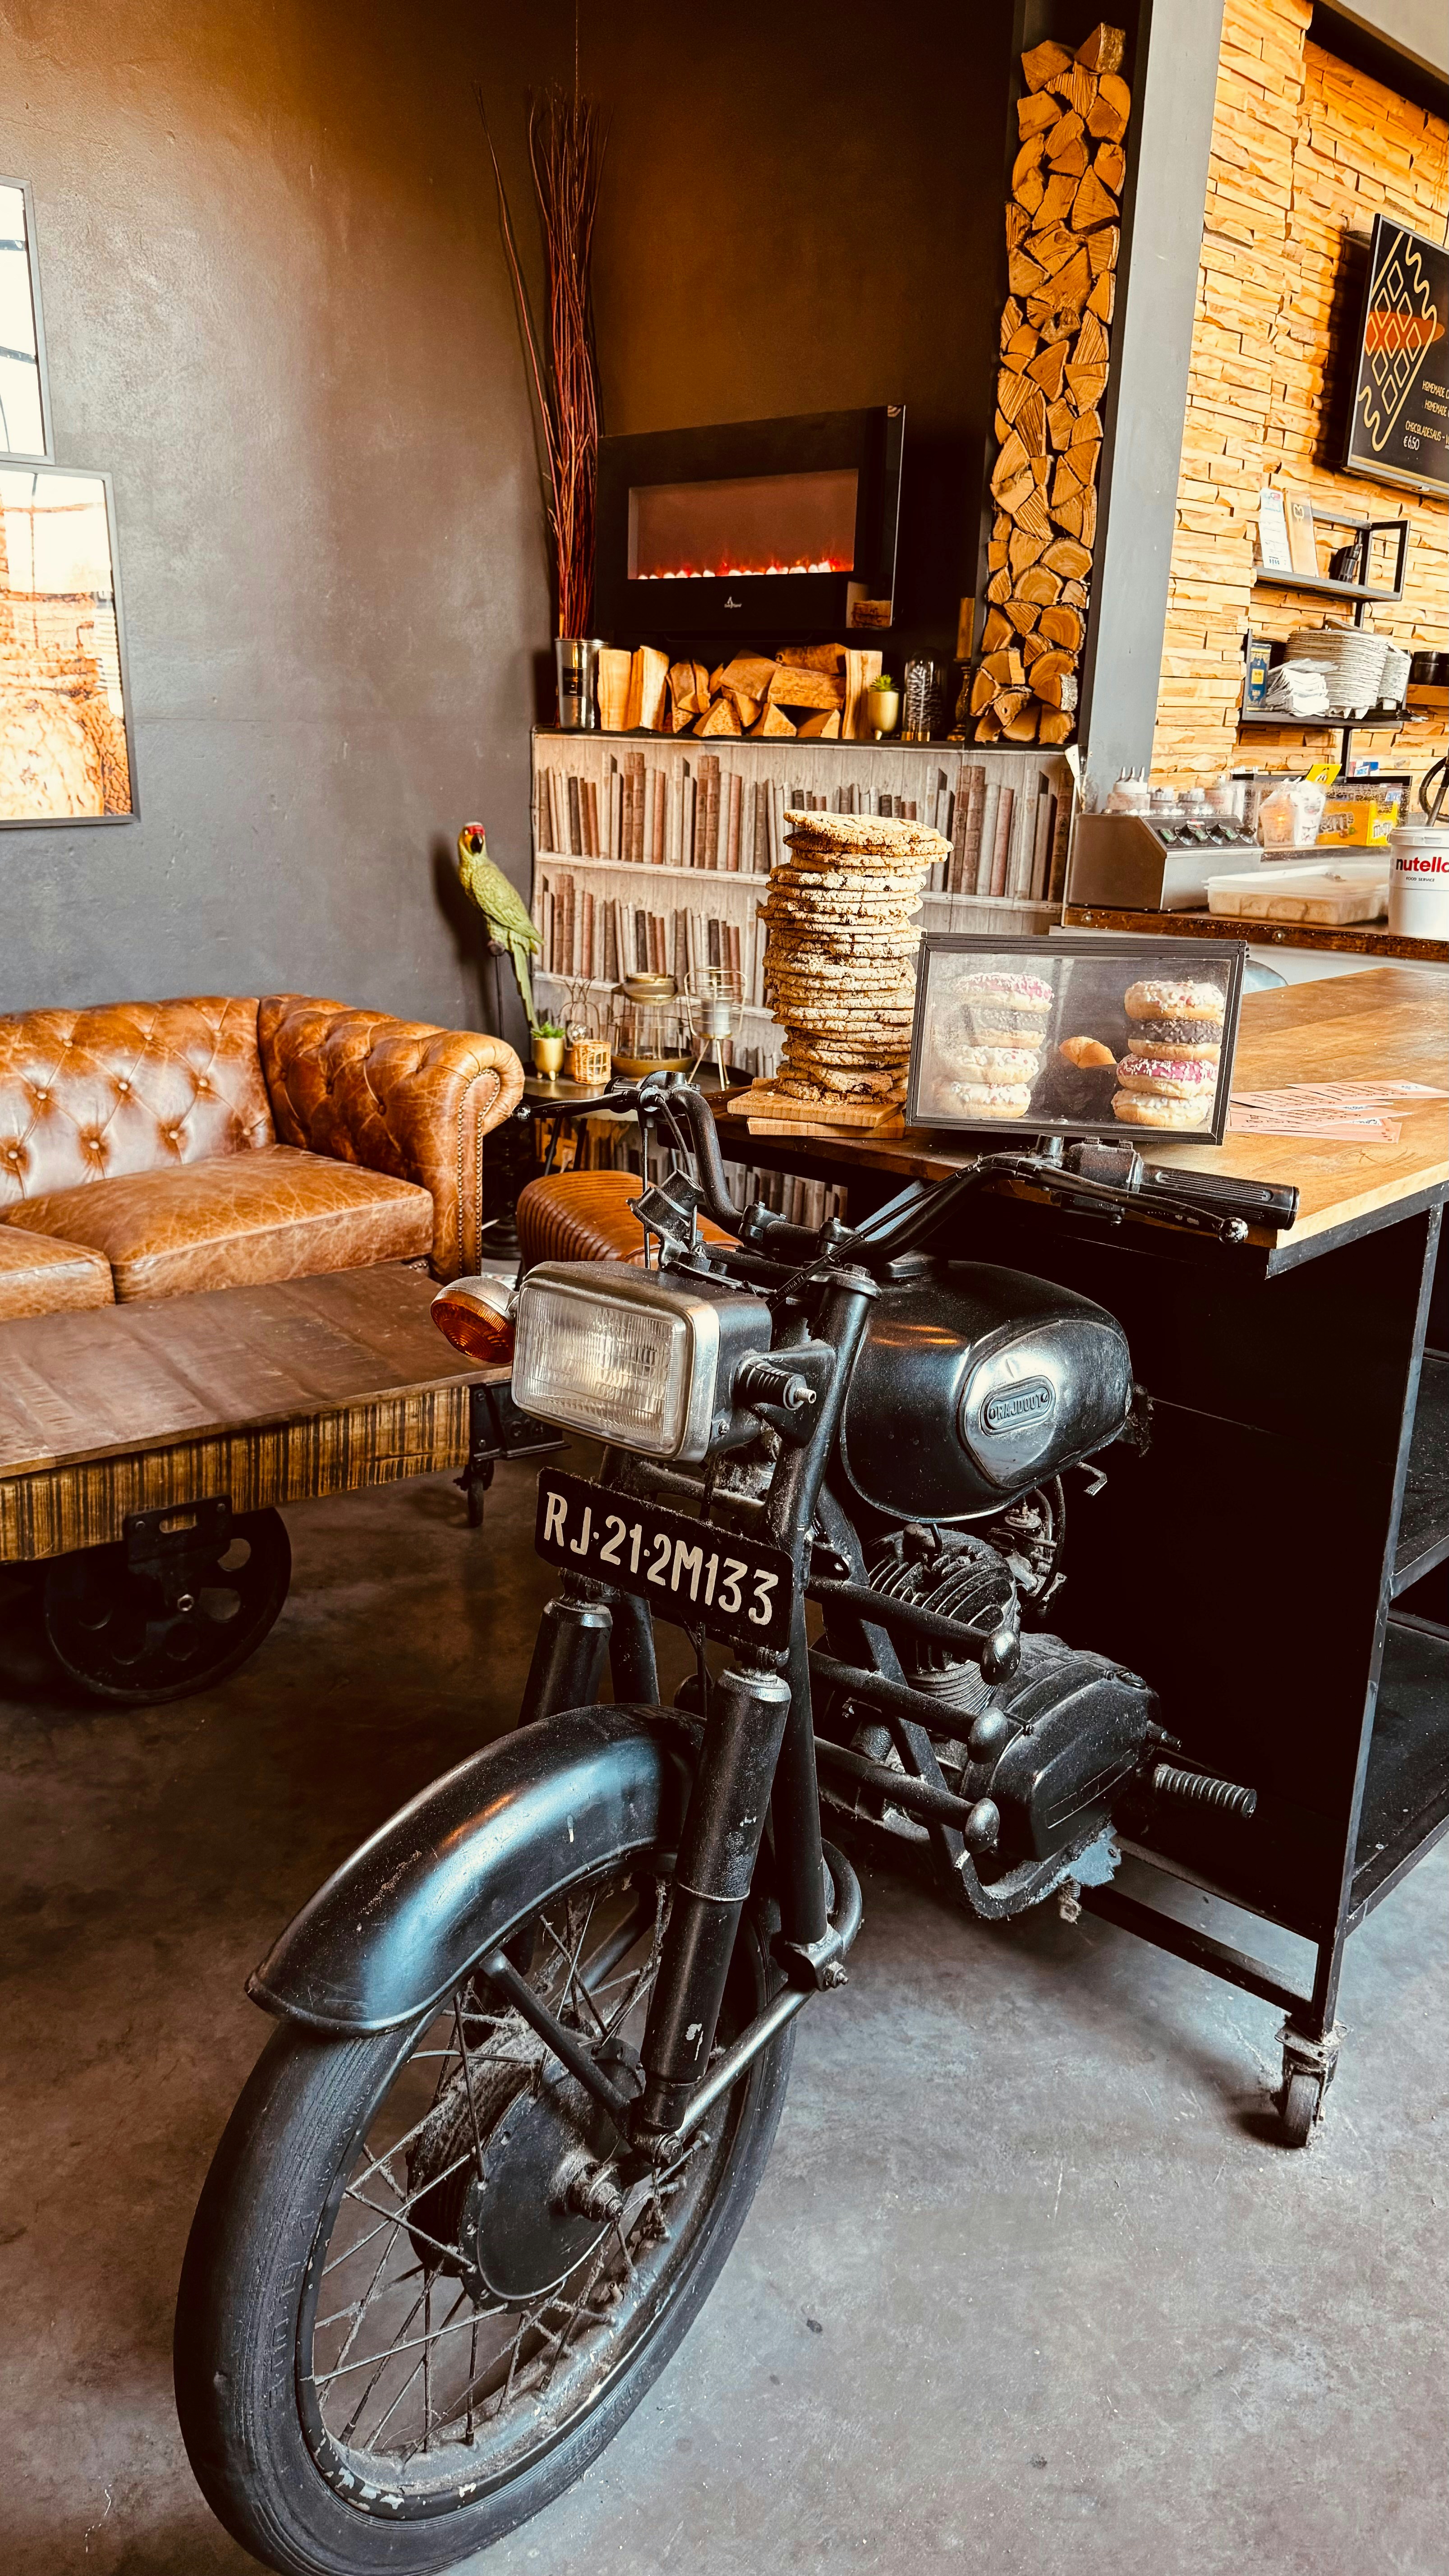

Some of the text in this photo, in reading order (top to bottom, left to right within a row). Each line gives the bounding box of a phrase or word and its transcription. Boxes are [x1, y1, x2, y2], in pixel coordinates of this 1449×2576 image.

[1422, 380, 1445, 398] HOMEMADE
[1425, 399, 1447, 417] HOMEMADE
[1405, 420, 1442, 442] CHOCOLADESAUS
[996, 1392, 1041, 1420] RAJDOOT
